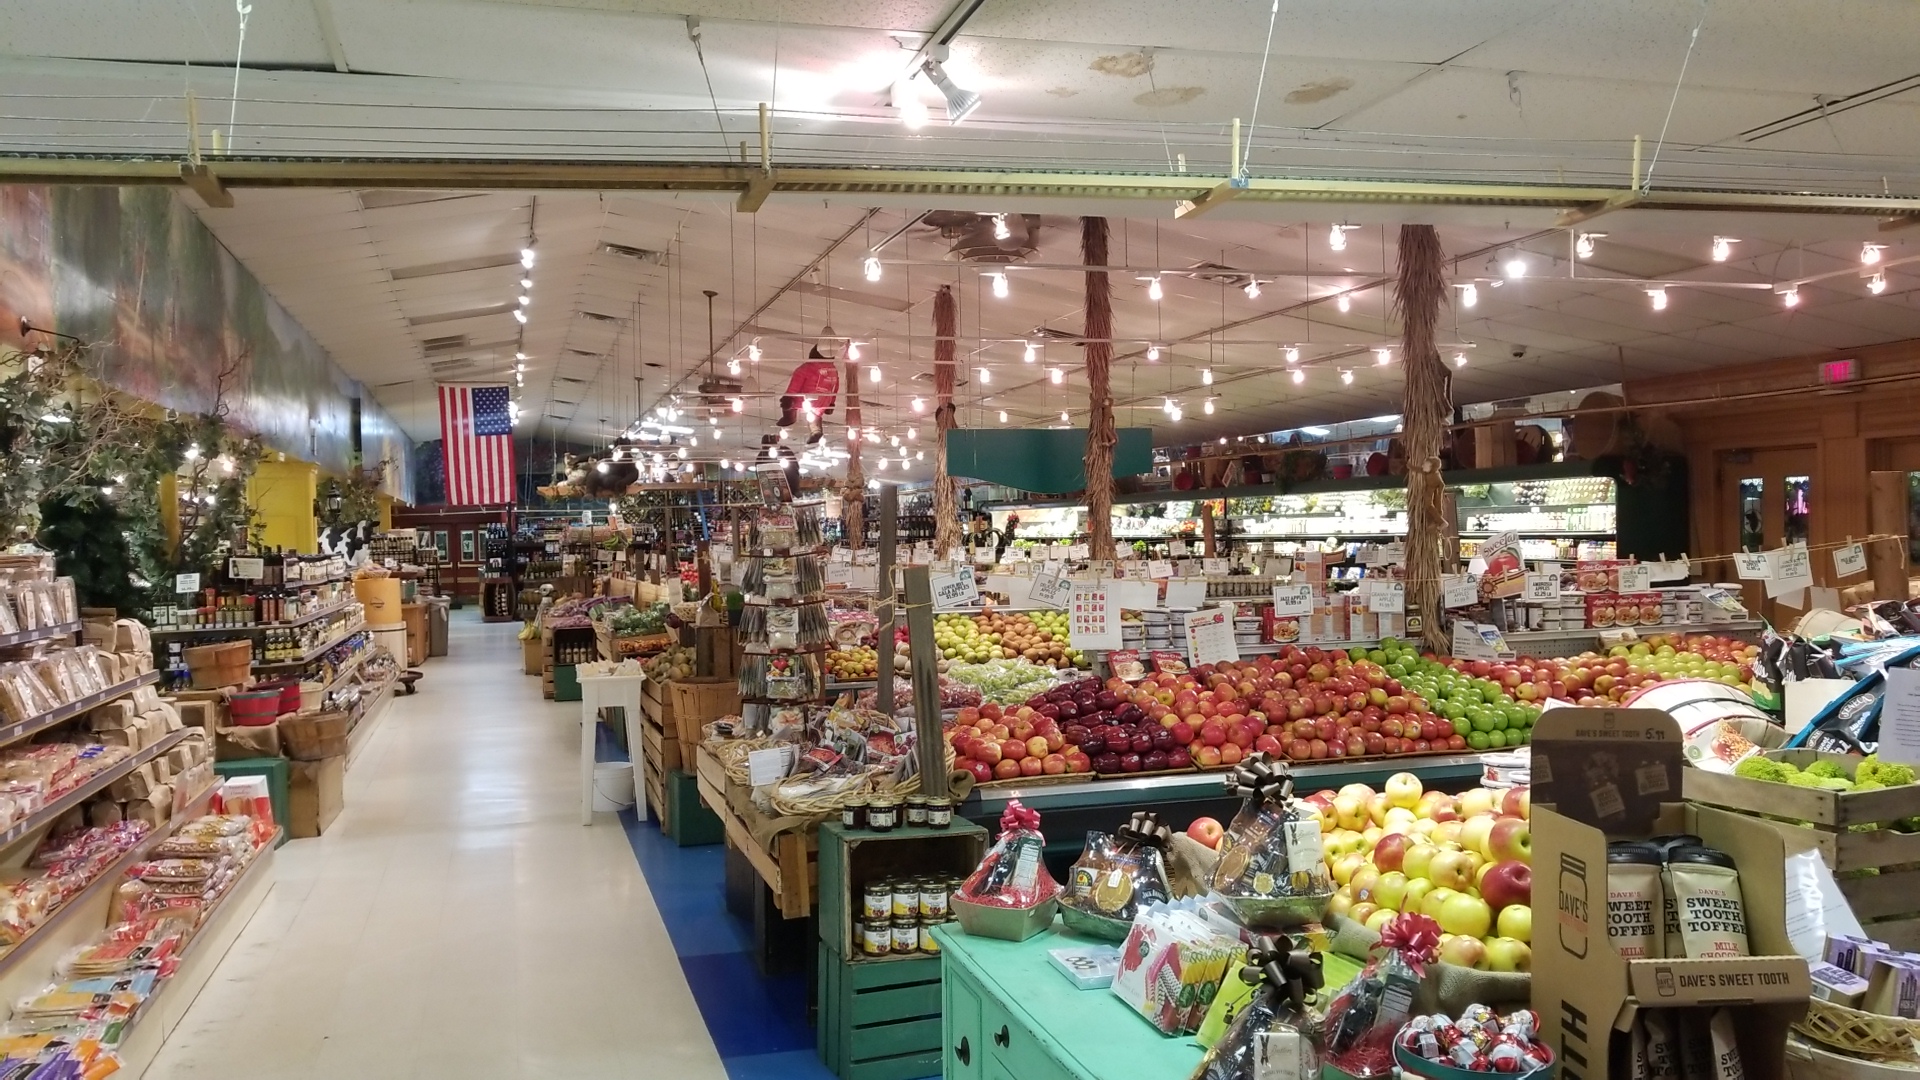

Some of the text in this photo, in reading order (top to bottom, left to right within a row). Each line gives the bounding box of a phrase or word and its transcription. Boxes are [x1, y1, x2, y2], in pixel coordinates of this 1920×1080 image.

[1840, 692, 1874, 719] SENECA
[1575, 729, 1640, 738] DAVE'S SWEET TOOTH
[1609, 891, 1642, 899] DAVE'S
[1698, 888, 1727, 896] DAVE'S
[1559, 890, 1588, 923] DAVE'S
[1607, 900, 1653, 912] WEET
[1686, 897, 1739, 910] SWEET
[1690, 909, 1742, 922] TOOTH
[1608, 925, 1655, 937] OFFEE
[1620, 947, 1645, 957] MILK
[1714, 942, 1739, 952] MILK
[1679, 972, 1790, 988] DAVE'S SWEET TOOTH
